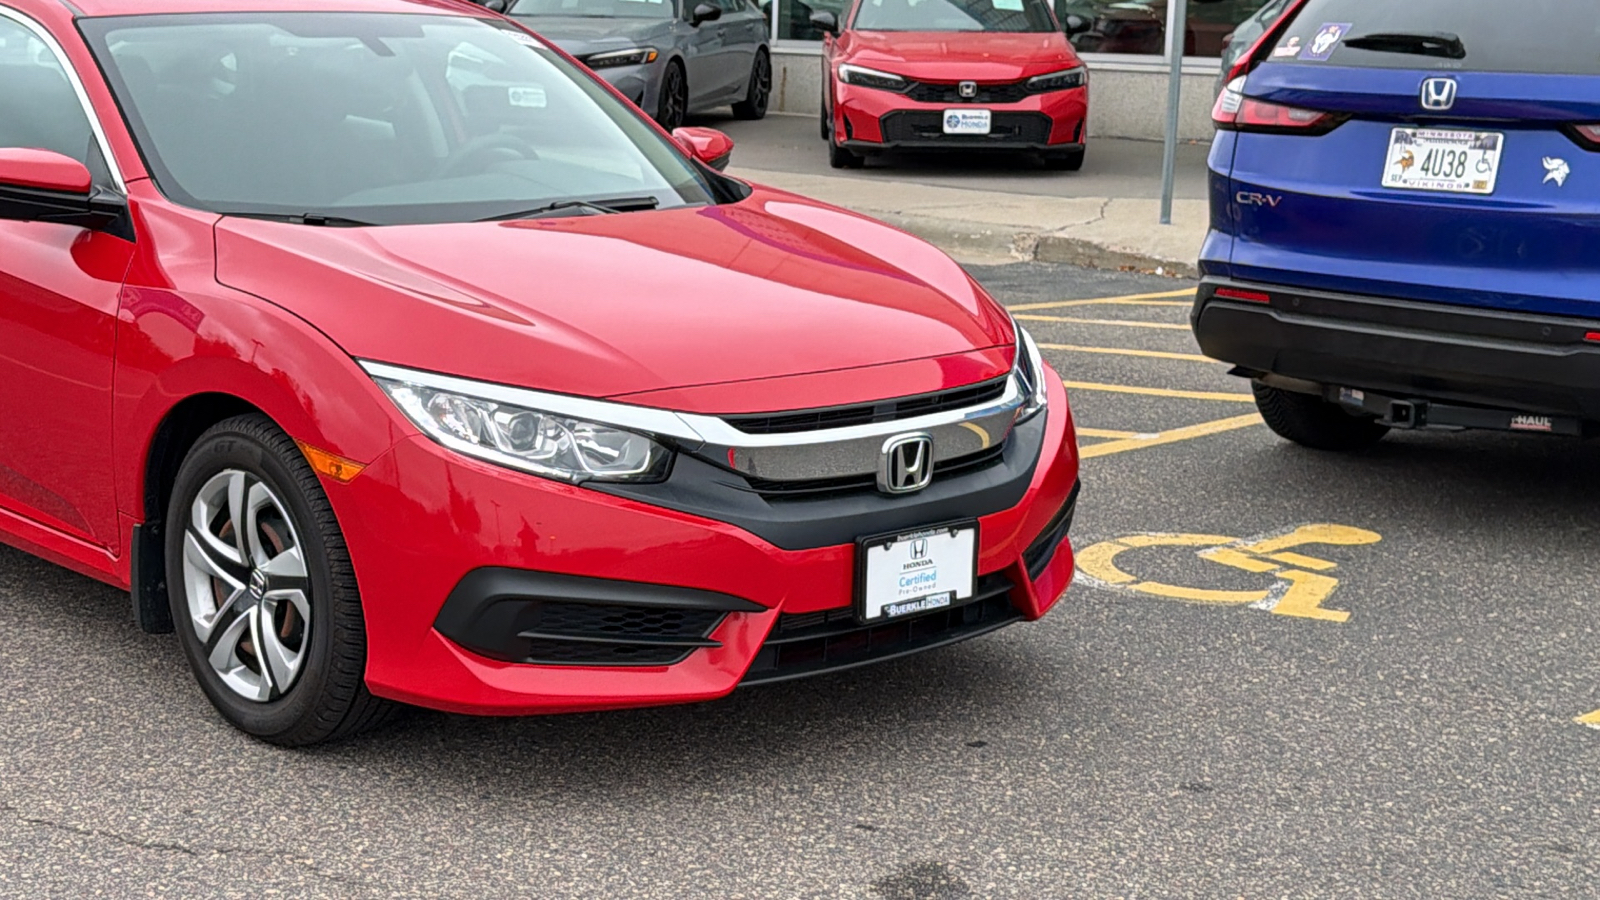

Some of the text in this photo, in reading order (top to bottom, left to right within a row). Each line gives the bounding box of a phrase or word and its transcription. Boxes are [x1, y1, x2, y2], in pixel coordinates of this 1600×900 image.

[1420, 148, 1468, 178] 4U38
[1236, 191, 1282, 207] CR-V
[902, 558, 934, 570] HONDA
[899, 569, 937, 588] Certified
[898, 582, 937, 596] Pre-Owned
[889, 596, 948, 615] BUERKLE HONDA
